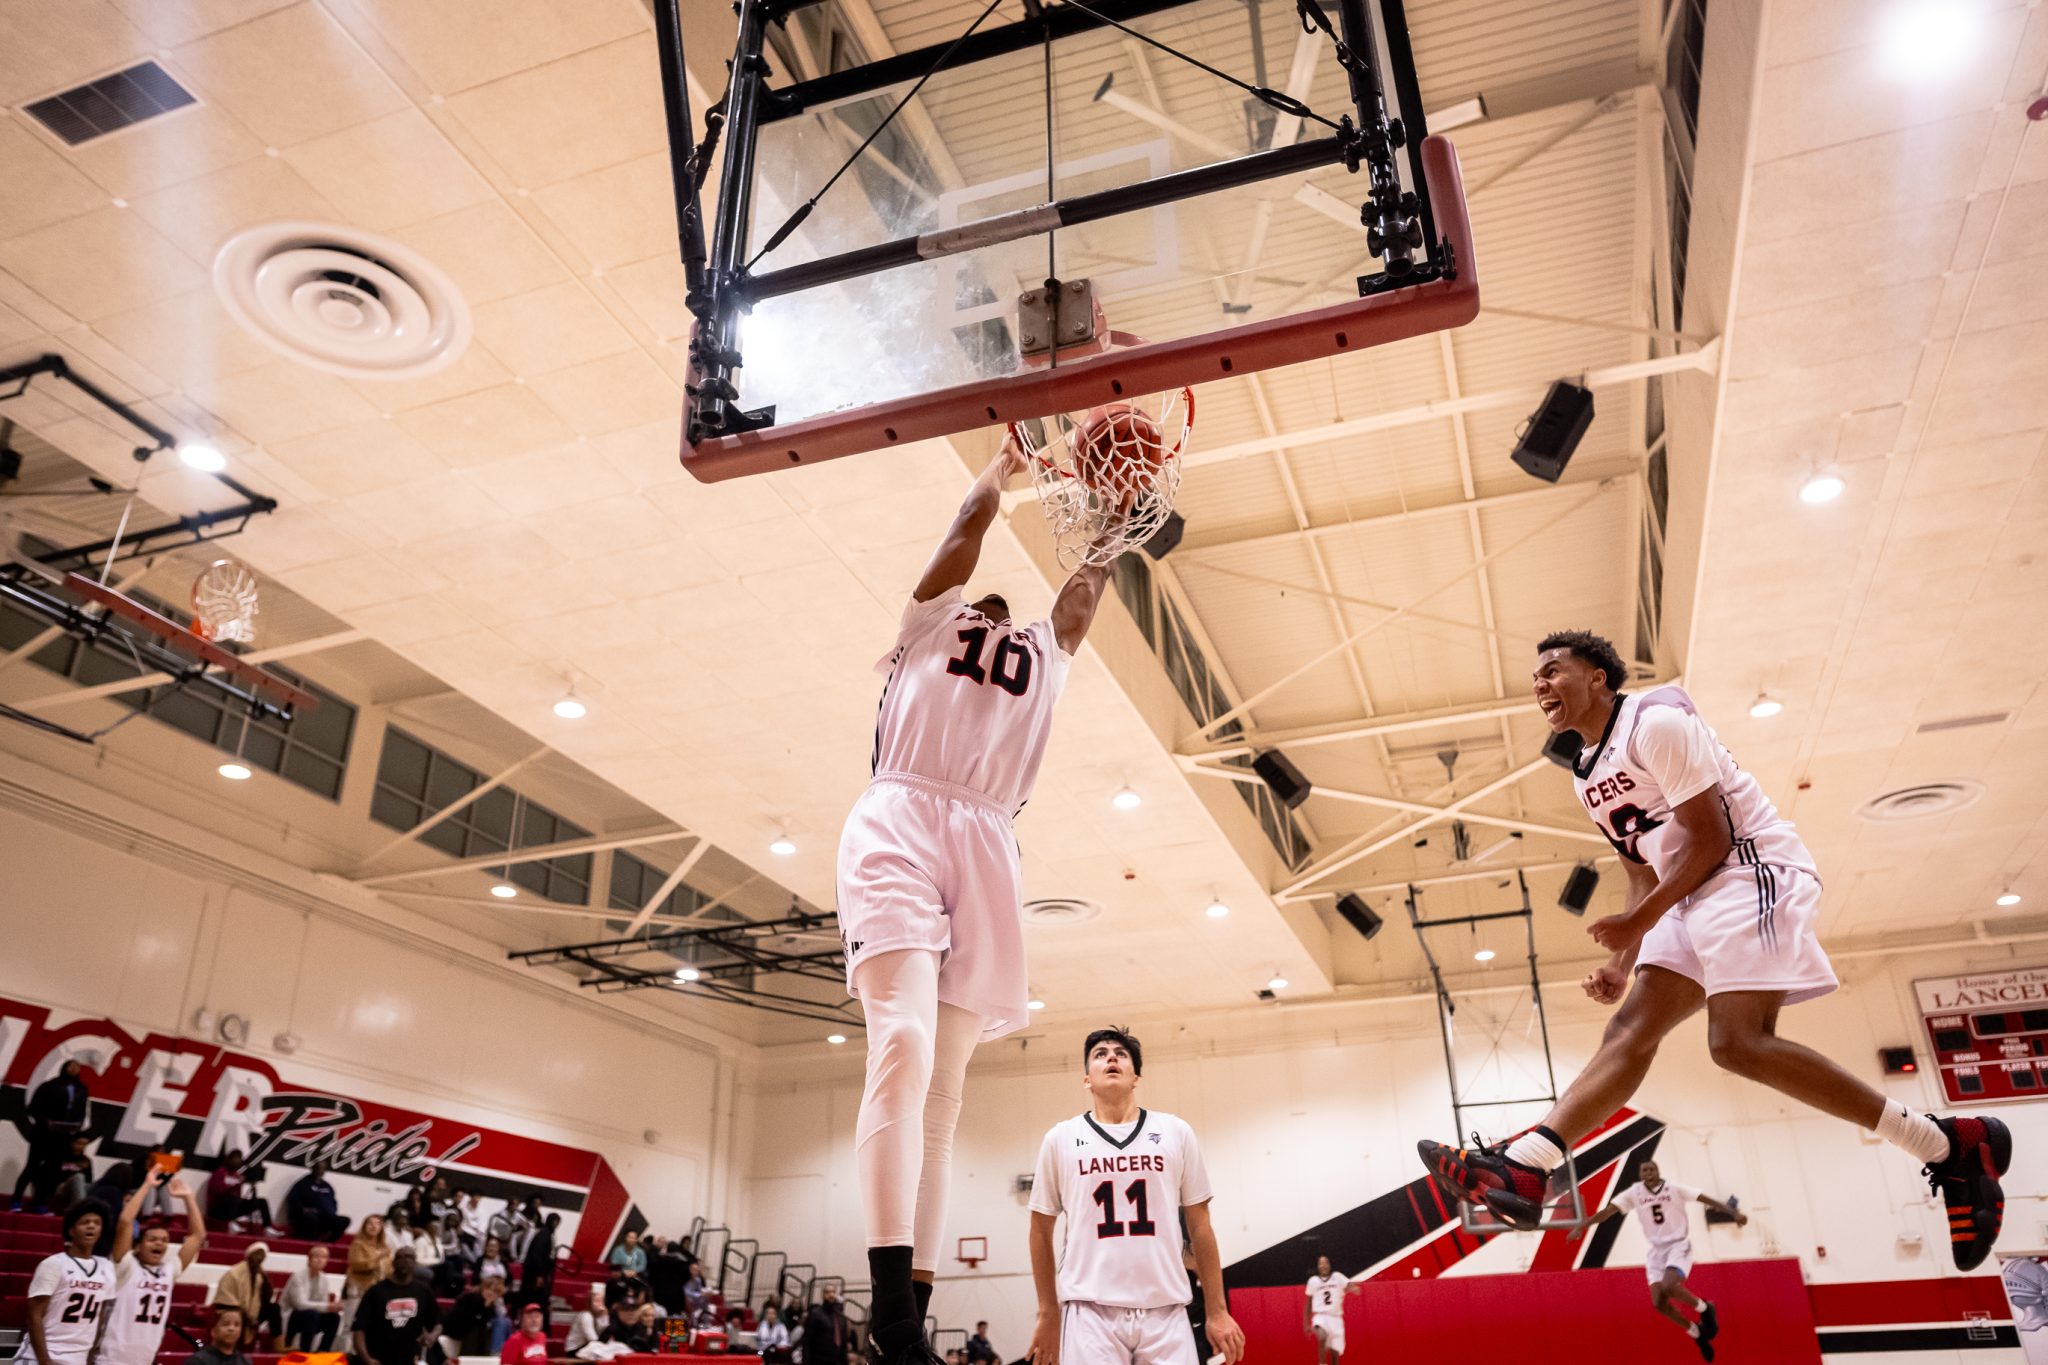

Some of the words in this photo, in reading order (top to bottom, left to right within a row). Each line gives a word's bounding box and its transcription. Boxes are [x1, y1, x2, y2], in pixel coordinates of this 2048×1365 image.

[946, 626, 1033, 697] 10
[1582, 770, 1637, 809] CERS
[1933, 983, 2048, 1008] LANCE
[238, 1091, 482, 1182] Pride!
[1078, 1155, 1165, 1176] LANCERS
[1092, 1178, 1156, 1240] 11
[1651, 1203, 1666, 1226] 5
[61, 1292, 100, 1324] 24
[135, 1293, 167, 1325] 13
[1323, 1290, 1333, 1306] 2
